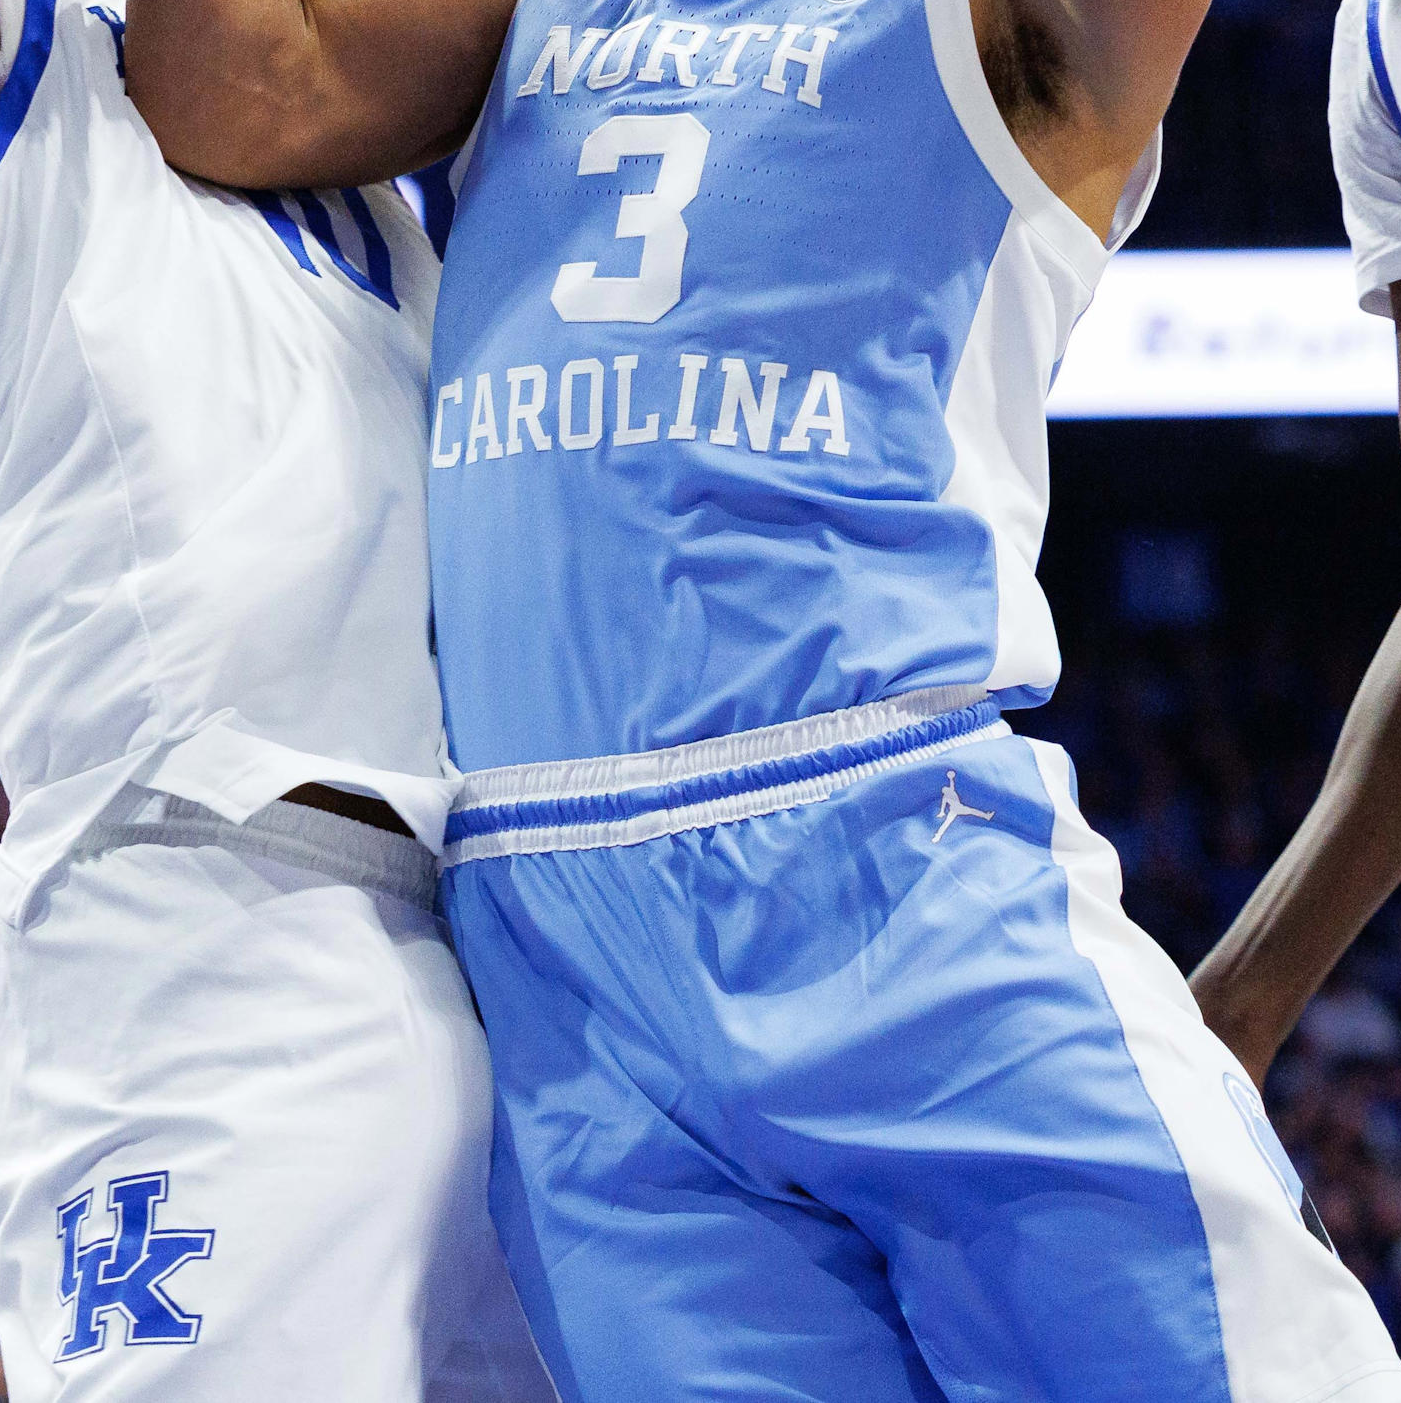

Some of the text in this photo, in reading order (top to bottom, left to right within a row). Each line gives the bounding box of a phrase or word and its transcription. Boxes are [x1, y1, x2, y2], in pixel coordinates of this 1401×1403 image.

[516, 14, 838, 109] NORTH
[550, 112, 711, 324] 3
[431, 353, 851, 470] CAROLINA
[53, 1169, 216, 1364] UK
